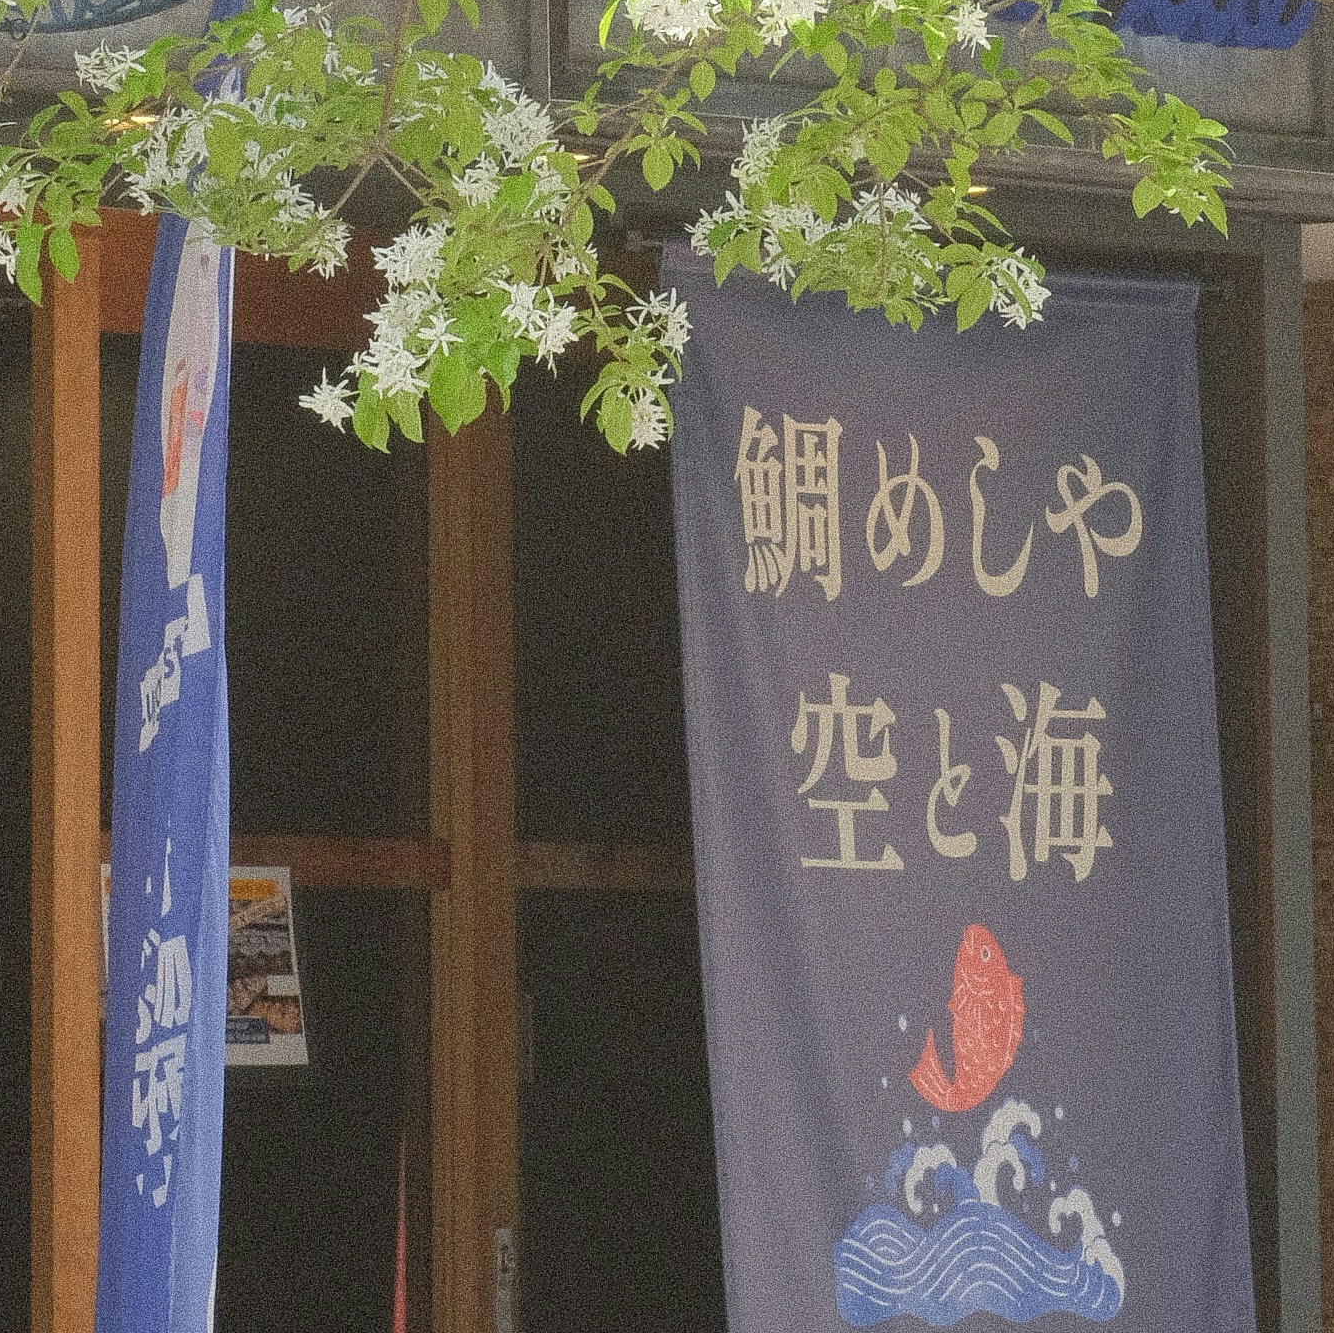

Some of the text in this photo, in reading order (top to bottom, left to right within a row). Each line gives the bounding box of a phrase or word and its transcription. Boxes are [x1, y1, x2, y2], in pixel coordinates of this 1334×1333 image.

[733, 403, 1144, 601] 鯛めしや
[790, 671, 1113, 883] 空と海
